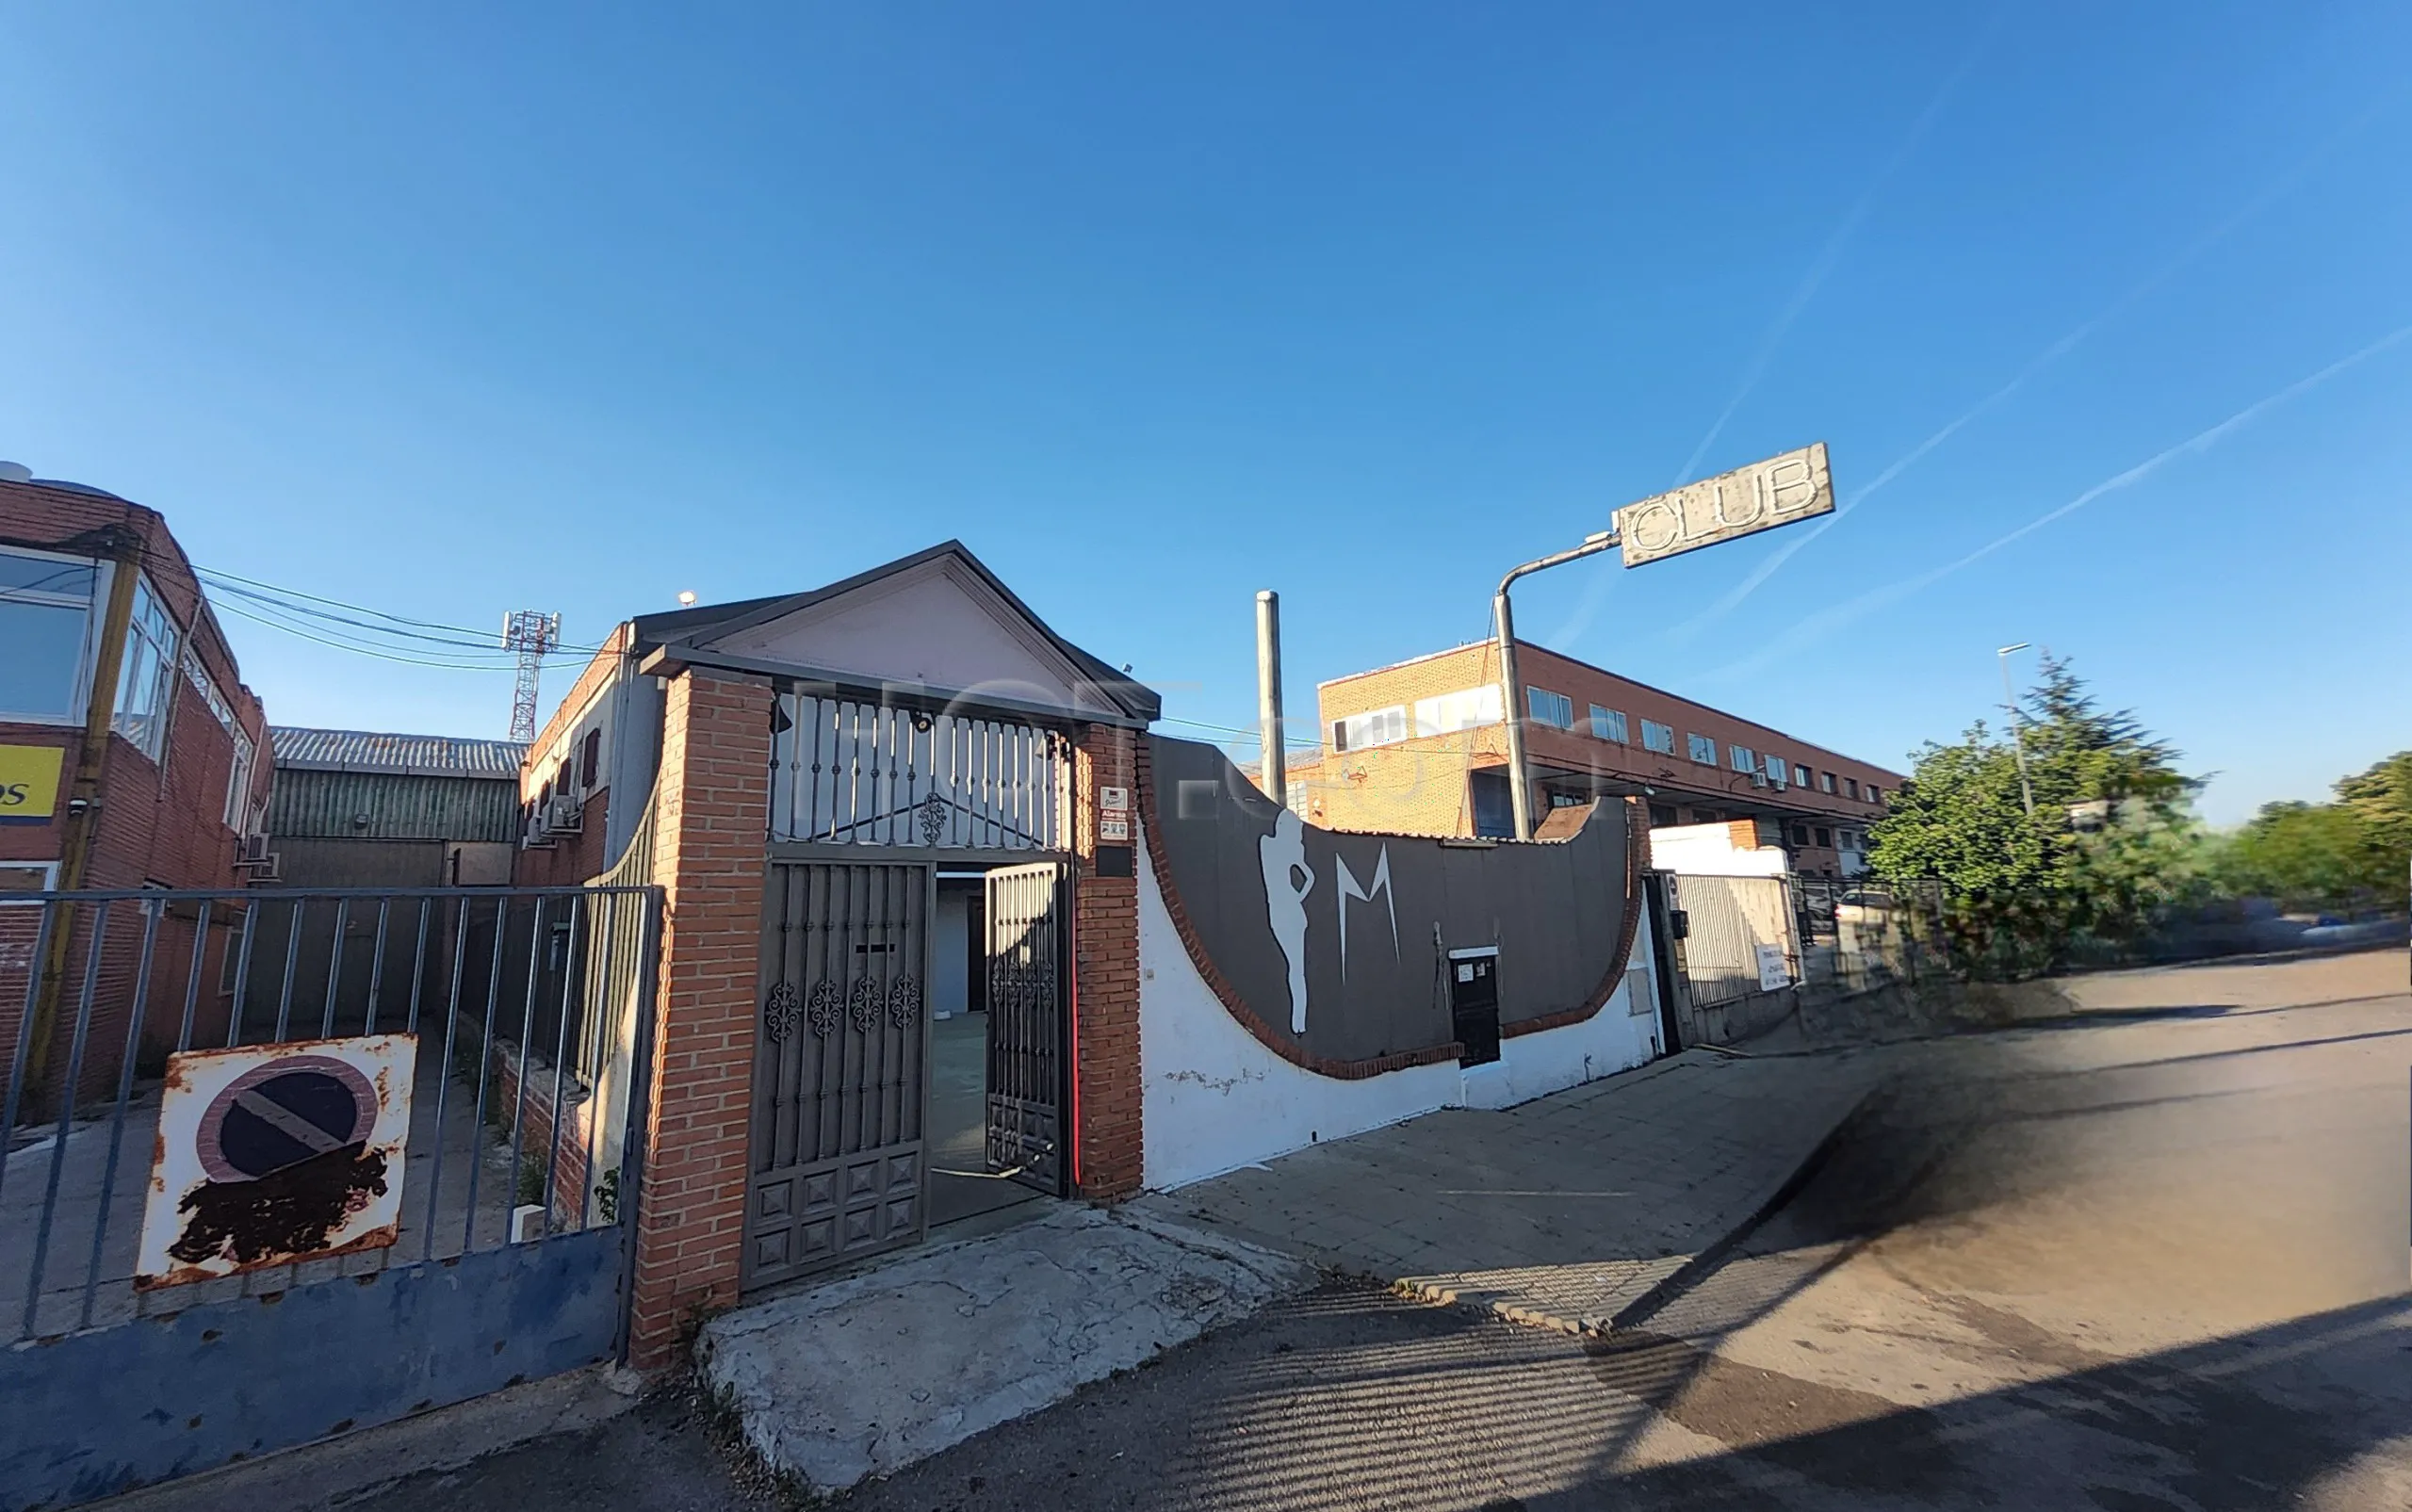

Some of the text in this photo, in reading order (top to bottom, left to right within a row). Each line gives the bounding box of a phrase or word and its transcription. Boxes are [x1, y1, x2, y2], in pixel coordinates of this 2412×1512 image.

[1630, 458, 1818, 551] CLUB
[0, 783, 29, 805] s
[1335, 841, 1401, 985] M
